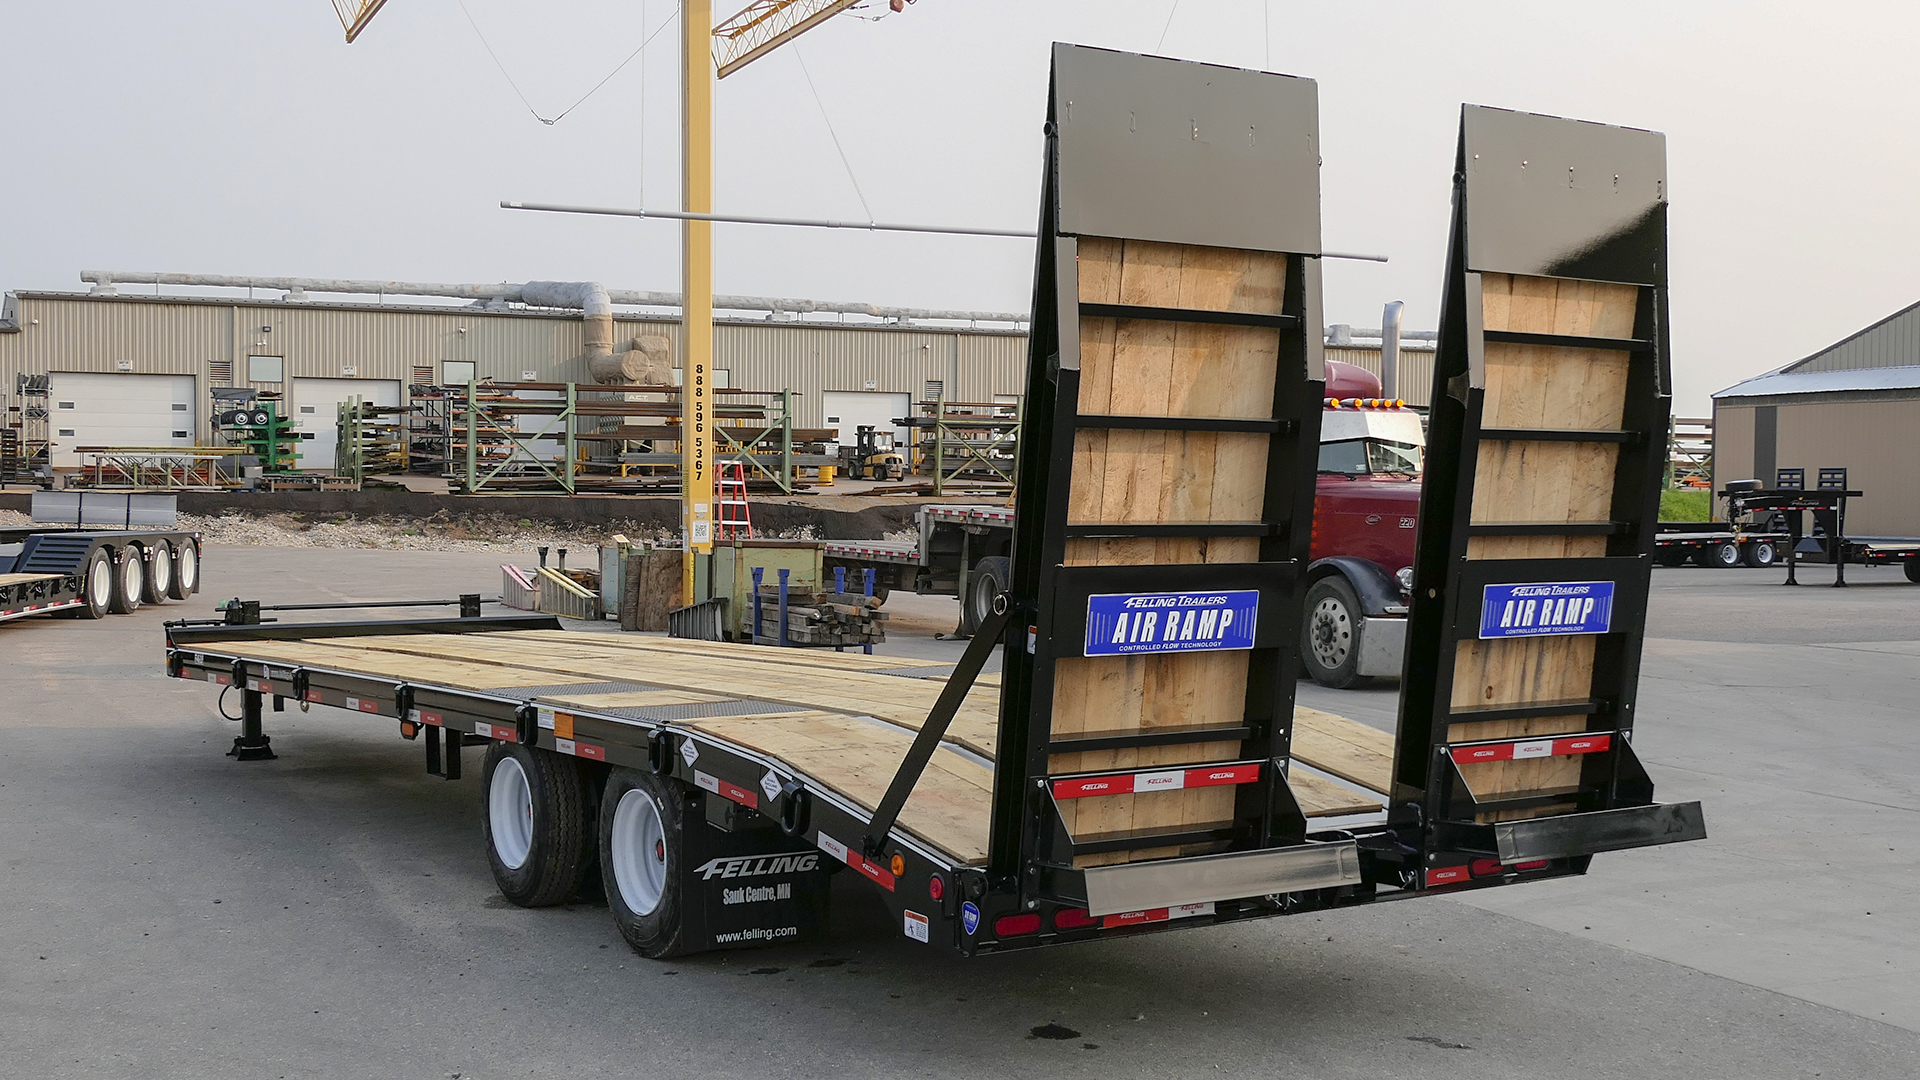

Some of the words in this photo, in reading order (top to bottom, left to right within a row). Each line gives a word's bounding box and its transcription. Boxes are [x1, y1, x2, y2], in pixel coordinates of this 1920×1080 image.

[1399, 518, 1415, 528] 220
[1510, 586, 1552, 597] FELLING
[1551, 585, 1590, 595] TRAILERS
[1123, 596, 1178, 608] FELLING
[1177, 595, 1228, 607] TRAILERS
[1500, 599, 1536, 627] AIR
[1539, 597, 1594, 625] RAMP
[1111, 611, 1158, 643] AIR
[1163, 609, 1234, 641] RAMP
[1119, 644, 1161, 652] CONTROLLED
[1180, 641, 1222, 649] TECHNOLOGY
[693, 850, 818, 880] FELLING
[723, 887, 745, 905] Sauk
[746, 882, 776, 903] Centre,
[777, 883, 791, 900] MN
[716, 926, 797, 943] www.felling.com
